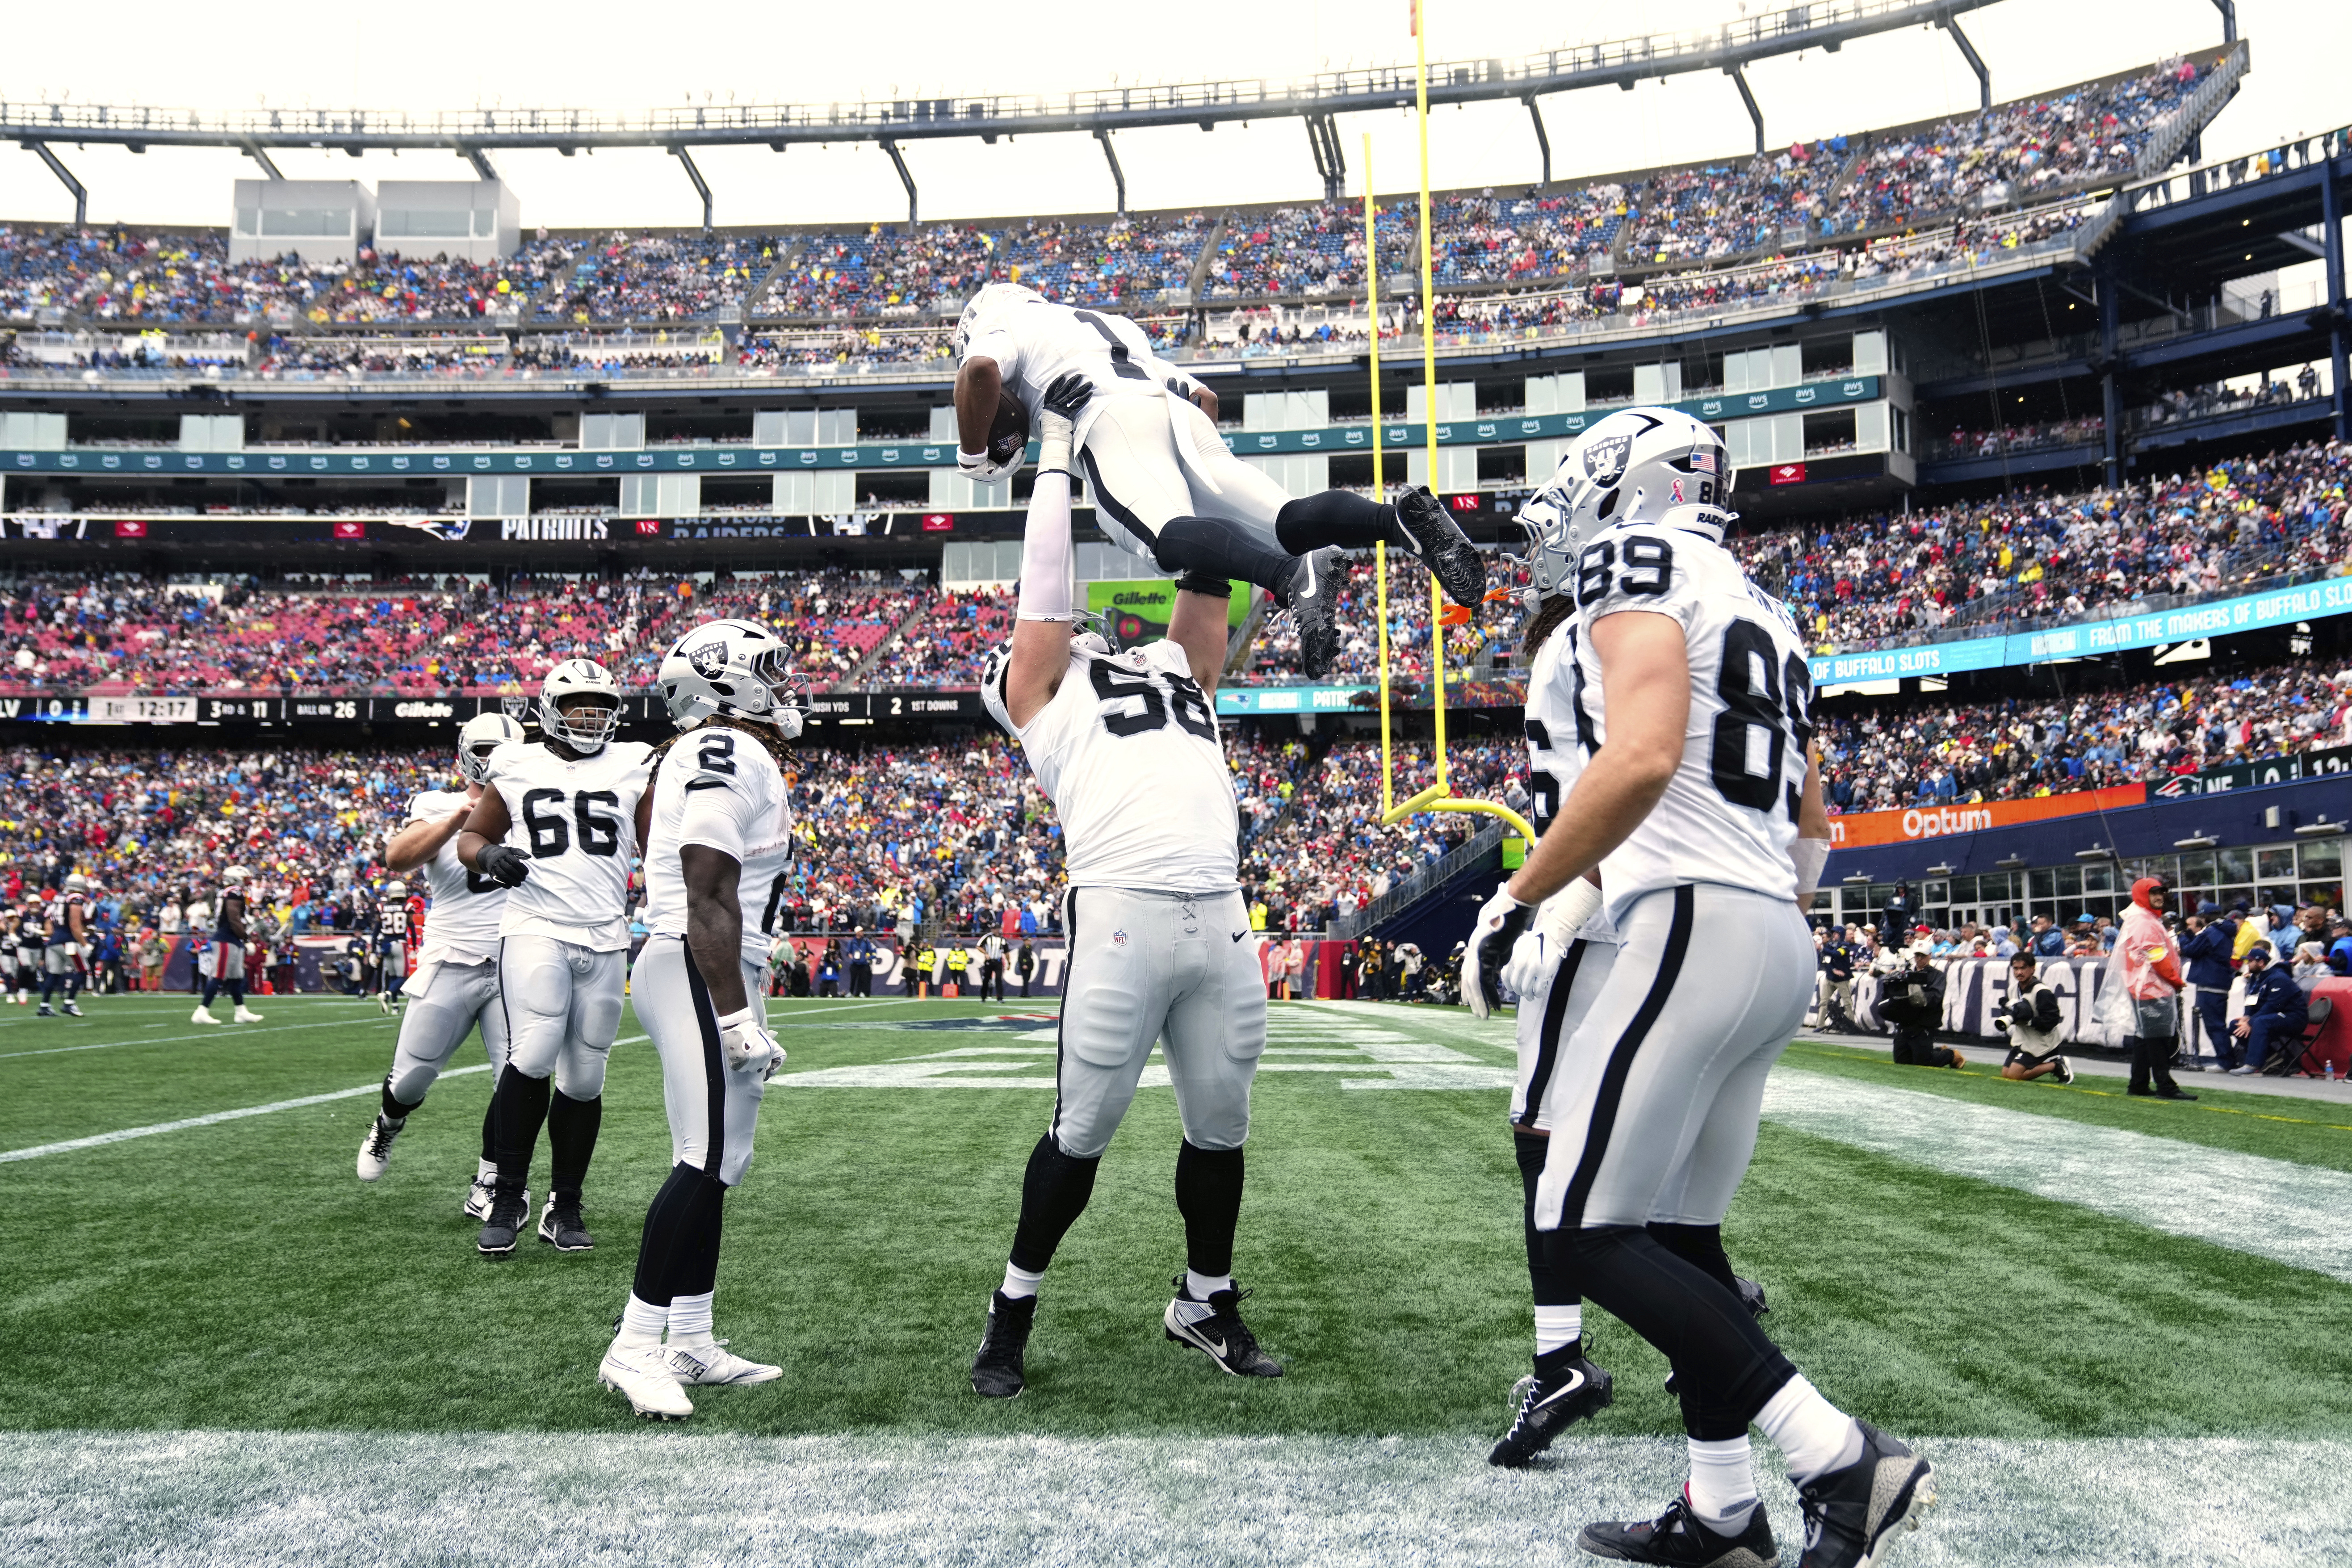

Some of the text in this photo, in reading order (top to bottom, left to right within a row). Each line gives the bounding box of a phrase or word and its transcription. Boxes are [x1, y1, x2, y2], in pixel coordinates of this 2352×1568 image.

[1073, 310, 1151, 380] 1
[1844, 381, 1863, 392] aws
[1796, 388, 1815, 398] aws
[1748, 394, 1767, 405] aws
[1702, 401, 1721, 411] aws
[1522, 420, 1539, 430] aws
[1566, 415, 1584, 426] aws
[1389, 428, 1407, 438] aws
[1478, 424, 1496, 433] aws
[1259, 435, 1276, 444] aws
[1302, 433, 1320, 443] aws
[1345, 431, 1363, 440] aws
[1586, 436, 1629, 454] RAIDERS
[718, 453, 734, 462] aws
[759, 452, 776, 461] aws
[800, 452, 817, 461] aws
[841, 450, 857, 460] aws
[882, 449, 898, 458] aws
[923, 448, 939, 457] aws
[433, 457, 449, 465] aws
[474, 457, 490, 465] aws
[515, 456, 531, 465] aws
[555, 456, 572, 465] aws
[596, 455, 612, 464] aws
[637, 454, 653, 464] aws
[677, 454, 694, 463] aws
[1578, 535, 1673, 607] 89
[1112, 591, 1167, 605] Gillette
[2090, 623, 2132, 648] FROM
[2136, 617, 2163, 641] THE
[2168, 608, 2230, 636] MAKERS
[2234, 602, 2250, 625] OF
[2256, 589, 2321, 620] BUFFALO
[692, 642, 723, 657] RAIDERS
[1135, 657, 1146, 666] NFL
[1813, 661, 1830, 680] OF
[1834, 655, 1895, 678] BUFFALO
[1899, 650, 1940, 671] SLOTS
[138, 701, 187, 717] 12:17
[252, 700, 268, 718] 11
[297, 701, 356, 718] BALL ON 26
[395, 702, 453, 717] Gillette
[832, 701, 850, 713] YDS
[891, 697, 958, 715] 2 1ST DOWNS
[698, 734, 737, 775] 2
[522, 788, 620, 859] 66
[1902, 807, 1991, 839] Optum
[380, 912, 407, 934] 28
[669, 1351, 709, 1380] NIKE
